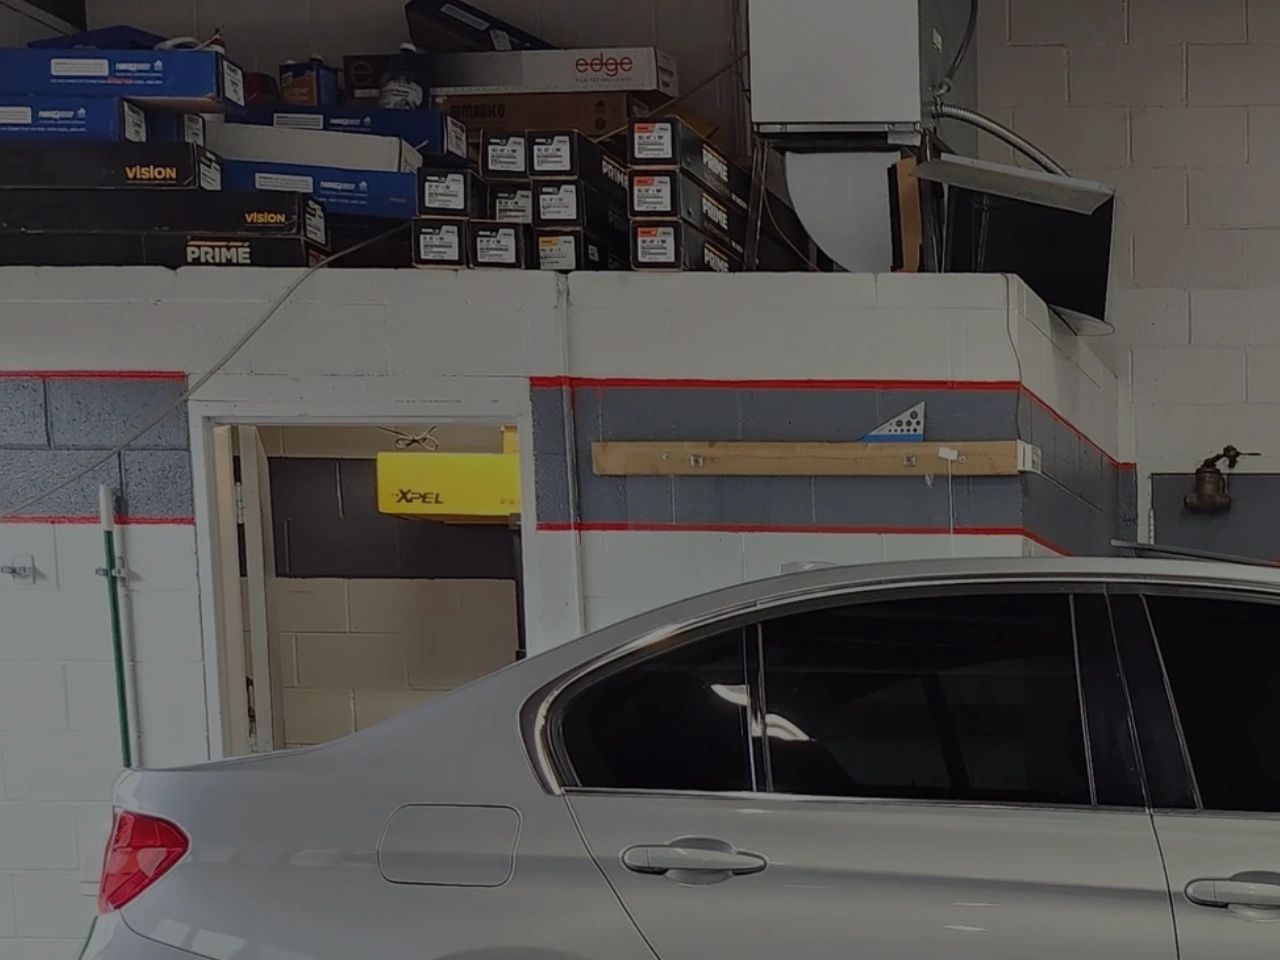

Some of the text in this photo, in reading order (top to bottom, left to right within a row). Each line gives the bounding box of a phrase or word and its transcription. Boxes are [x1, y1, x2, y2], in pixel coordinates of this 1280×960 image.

[575, 52, 633, 77] edge
[186, 246, 251, 263] PRIME
[396, 488, 444, 504] XPEL
